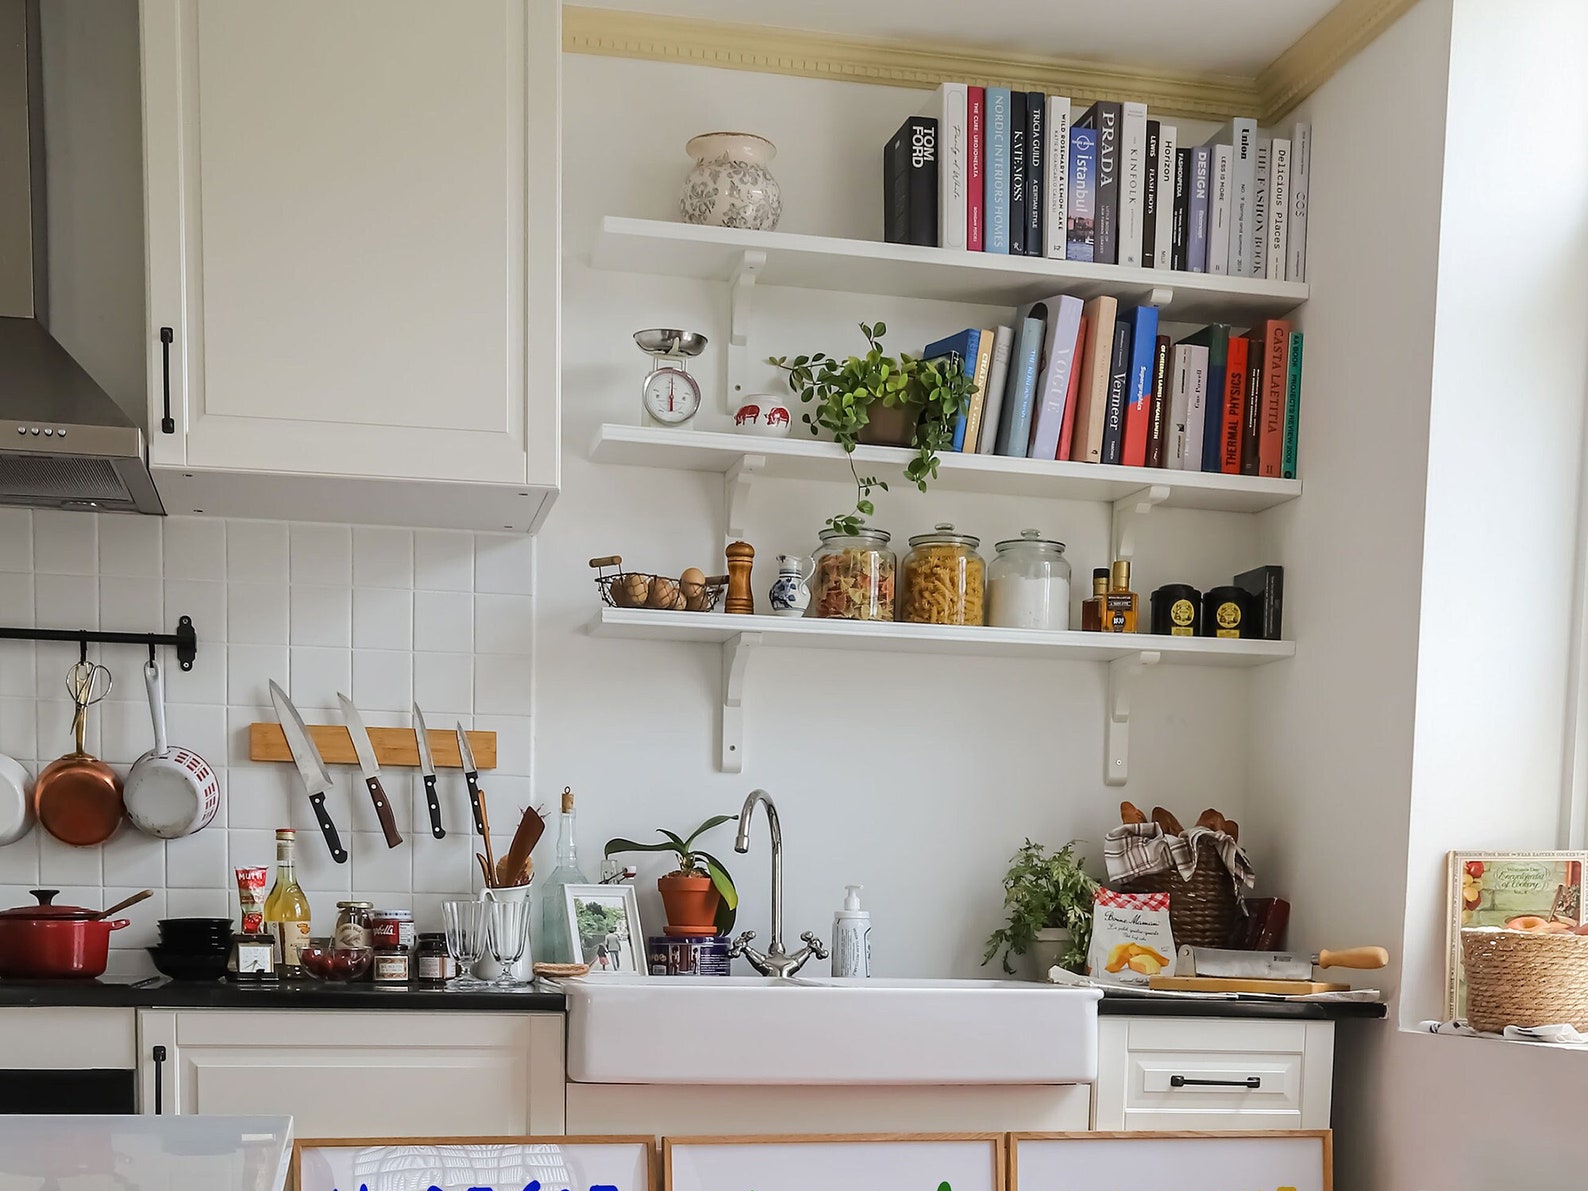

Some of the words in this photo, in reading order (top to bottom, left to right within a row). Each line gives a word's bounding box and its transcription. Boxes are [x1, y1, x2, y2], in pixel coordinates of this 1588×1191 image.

[994, 96, 1005, 139] NORDIC
[1032, 109, 1041, 137] TRICIA
[912, 126, 923, 168] FORD
[923, 127, 935, 161] TOM
[1013, 131, 1023, 164] KATE
[1032, 140, 1041, 166] GUILD
[1100, 112, 1115, 187] PRADA
[1163, 140, 1173, 182] Horizon
[1240, 128, 1251, 160] Union
[1257, 148, 1267, 174] THE
[993, 144, 1004, 203] INTERIORS
[1013, 167, 1022, 201] MOSS
[1129, 148, 1138, 205] KINFOLK
[1196, 152, 1207, 199] DESIGN
[1275, 150, 1287, 207] Delicious
[1255, 178, 1266, 233] FASHION
[1295, 191, 1306, 217] COS
[993, 206, 1003, 248] HOMES
[1273, 212, 1284, 249] Places
[1253, 236, 1264, 274] BOOK
[1270, 328, 1285, 370] CASTA
[1291, 347, 1299, 368] BOOK
[1292, 334, 1300, 346] AA
[1047, 348, 1071, 414] VOGUE
[1109, 372, 1127, 430] Vermeer
[1136, 366, 1148, 411] Supergraphics
[1229, 371, 1243, 415] PHYSICS
[1288, 374, 1298, 413] PROJECTS
[1267, 374, 1281, 433] LAETITIA
[1226, 421, 1240, 466] THERMAL
[1287, 414, 1296, 444] REVIEW
